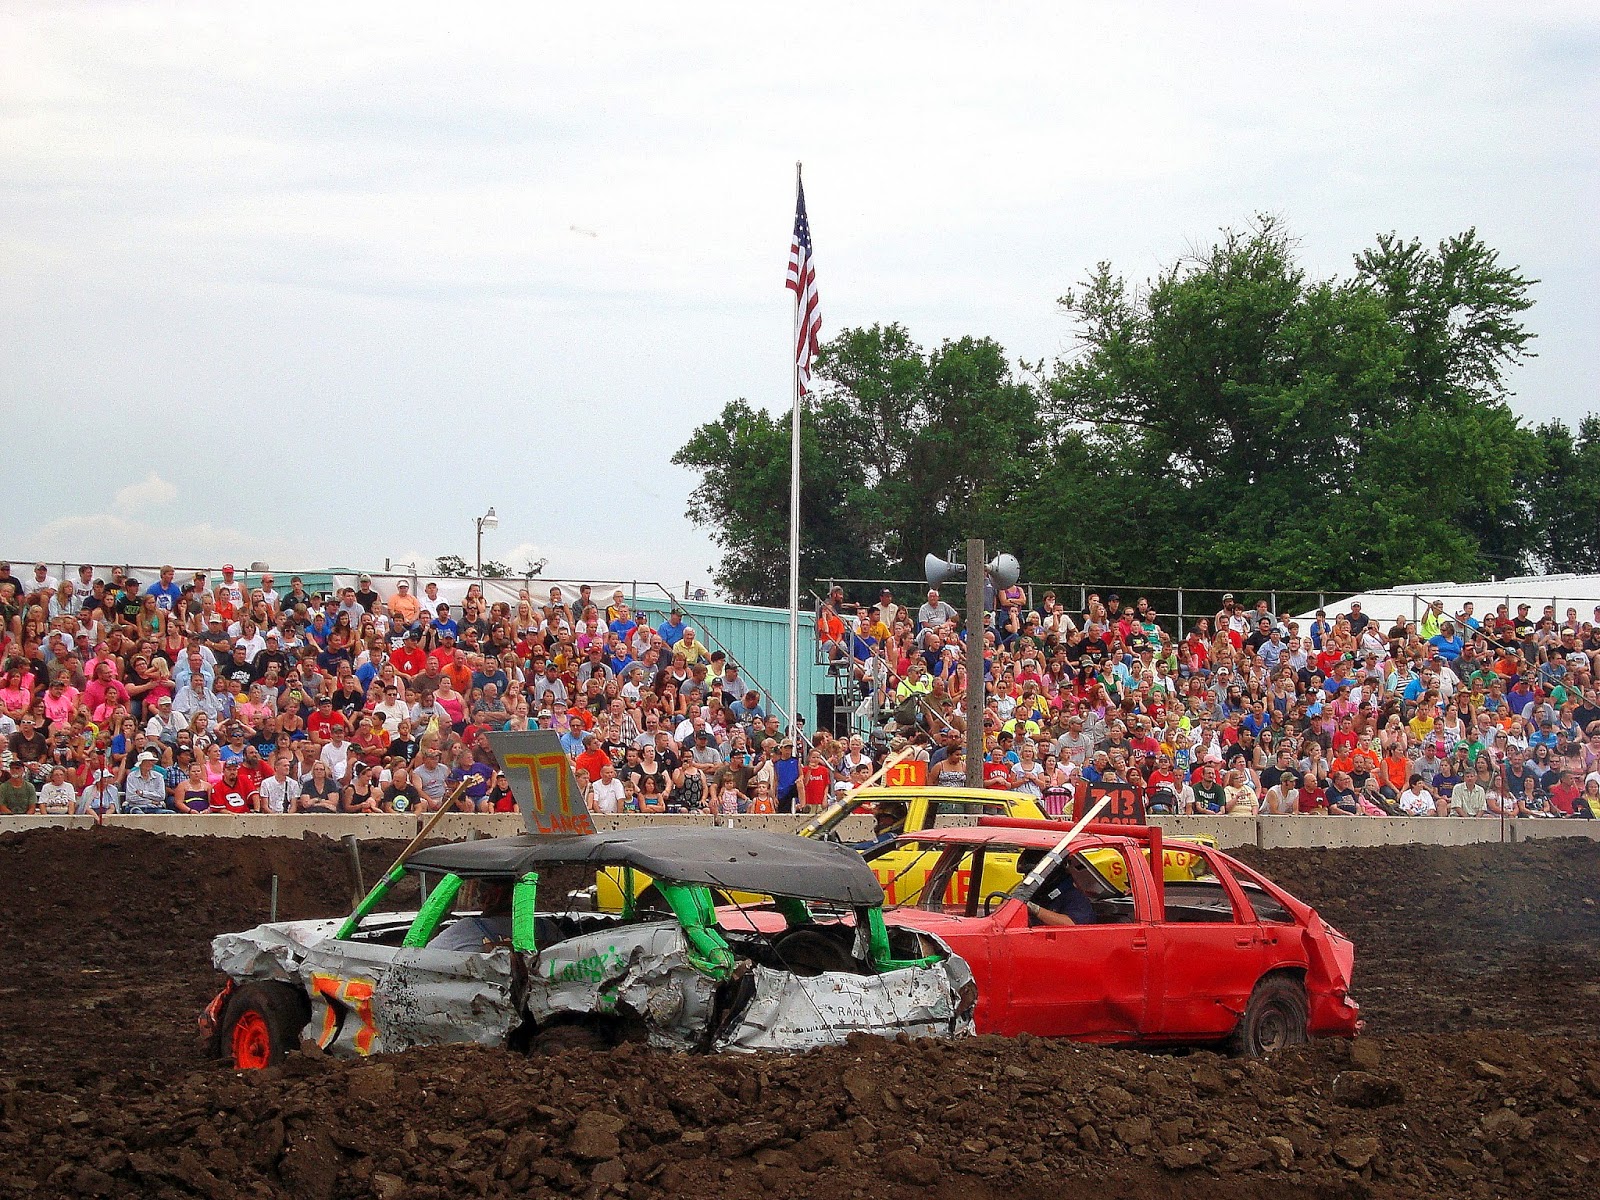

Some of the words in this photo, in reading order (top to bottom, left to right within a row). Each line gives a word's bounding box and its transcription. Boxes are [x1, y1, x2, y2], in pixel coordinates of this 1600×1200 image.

[503, 753, 570, 815] 77
[891, 763, 917, 786] J1
[225, 792, 245, 807] 8
[1090, 788, 1135, 816] 713
[531, 810, 594, 835] LANGE
